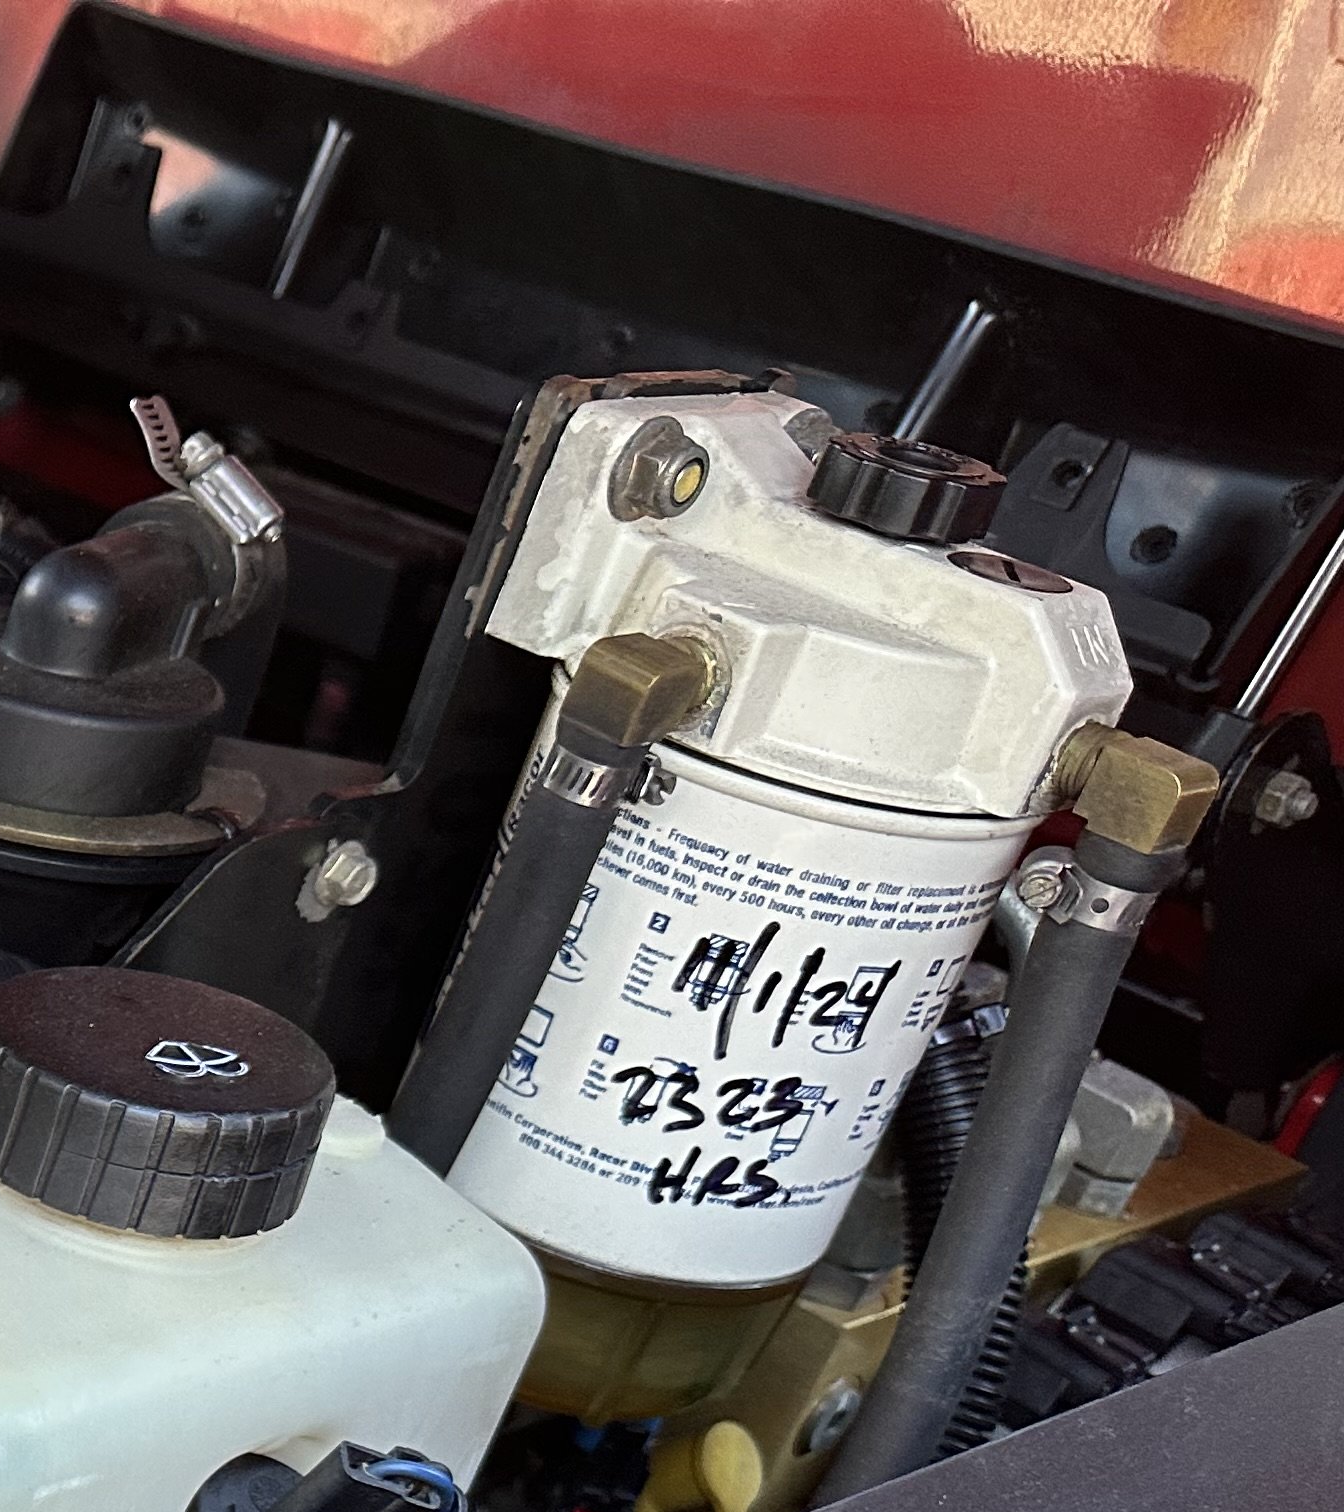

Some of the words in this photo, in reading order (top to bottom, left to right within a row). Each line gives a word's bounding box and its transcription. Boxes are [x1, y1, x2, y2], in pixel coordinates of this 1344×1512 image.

[730, 870, 744, 883] or
[736, 853, 752, 866] of
[756, 858, 794, 878] water
[856, 881, 871, 892] or
[738, 890, 766, 908] 500
[616, 1172, 641, 1187] 209
